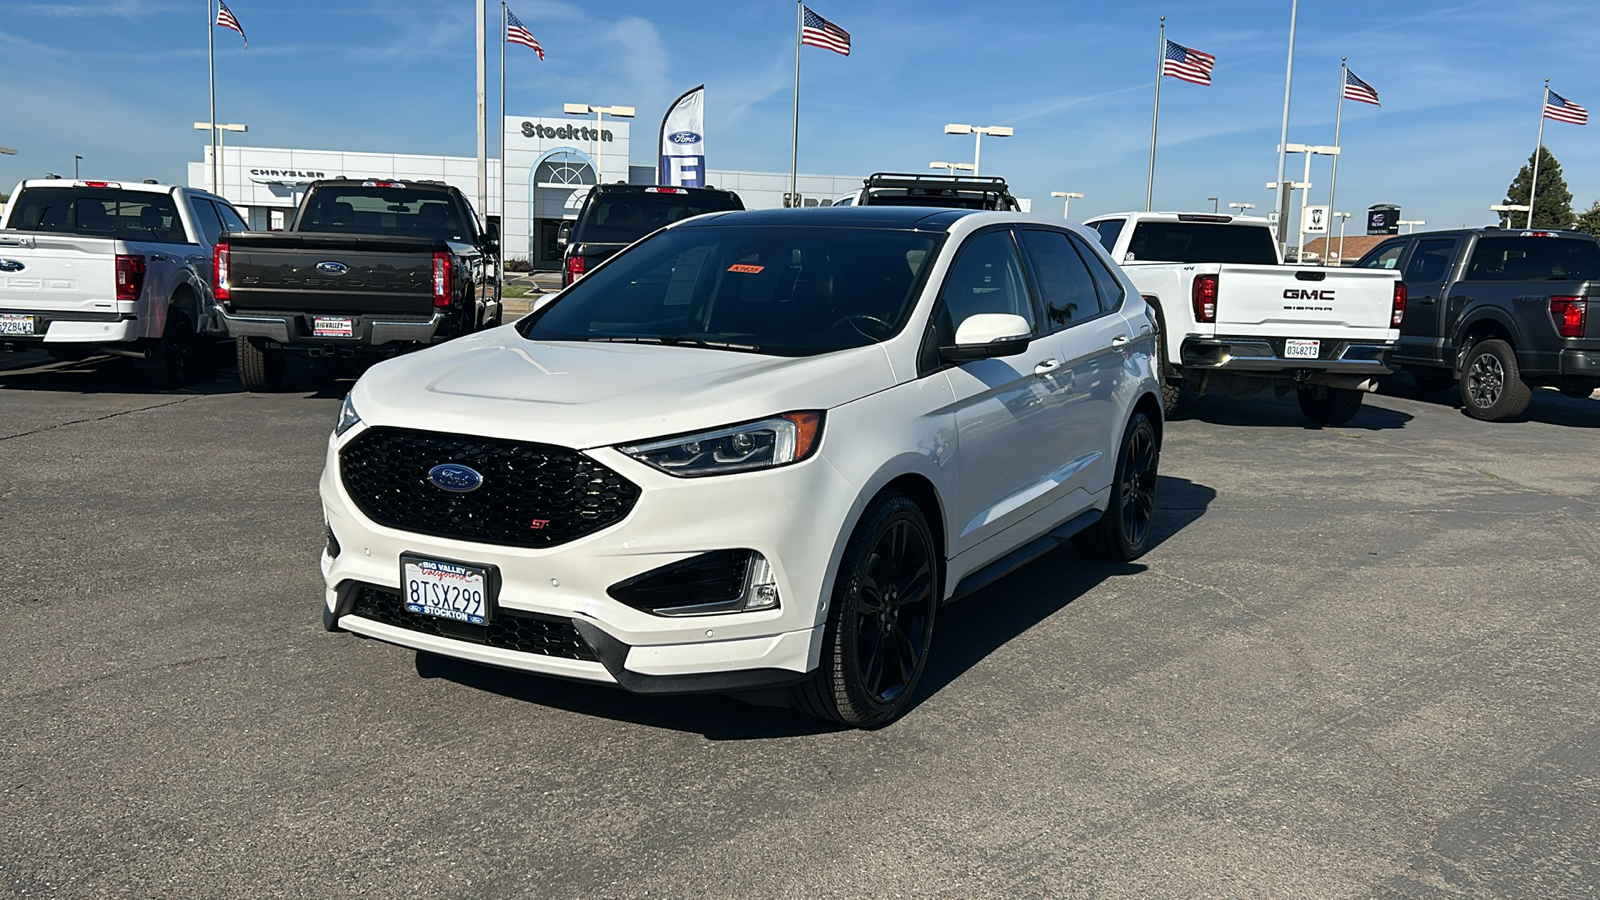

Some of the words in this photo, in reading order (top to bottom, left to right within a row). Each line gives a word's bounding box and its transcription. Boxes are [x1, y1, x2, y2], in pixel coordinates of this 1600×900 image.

[521, 121, 613, 142] Stockton
[673, 132, 698, 144] Ford
[250, 169, 325, 178] CHRYSLER
[1283, 289, 1335, 300] GMC
[1287, 347, 1317, 356] 03482T3
[530, 519, 550, 529] ST
[422, 561, 437, 569] BIG
[437, 564, 466, 575] VALLEY
[410, 580, 481, 614] 8TSX299
[424, 605, 468, 621] STOCKTON
